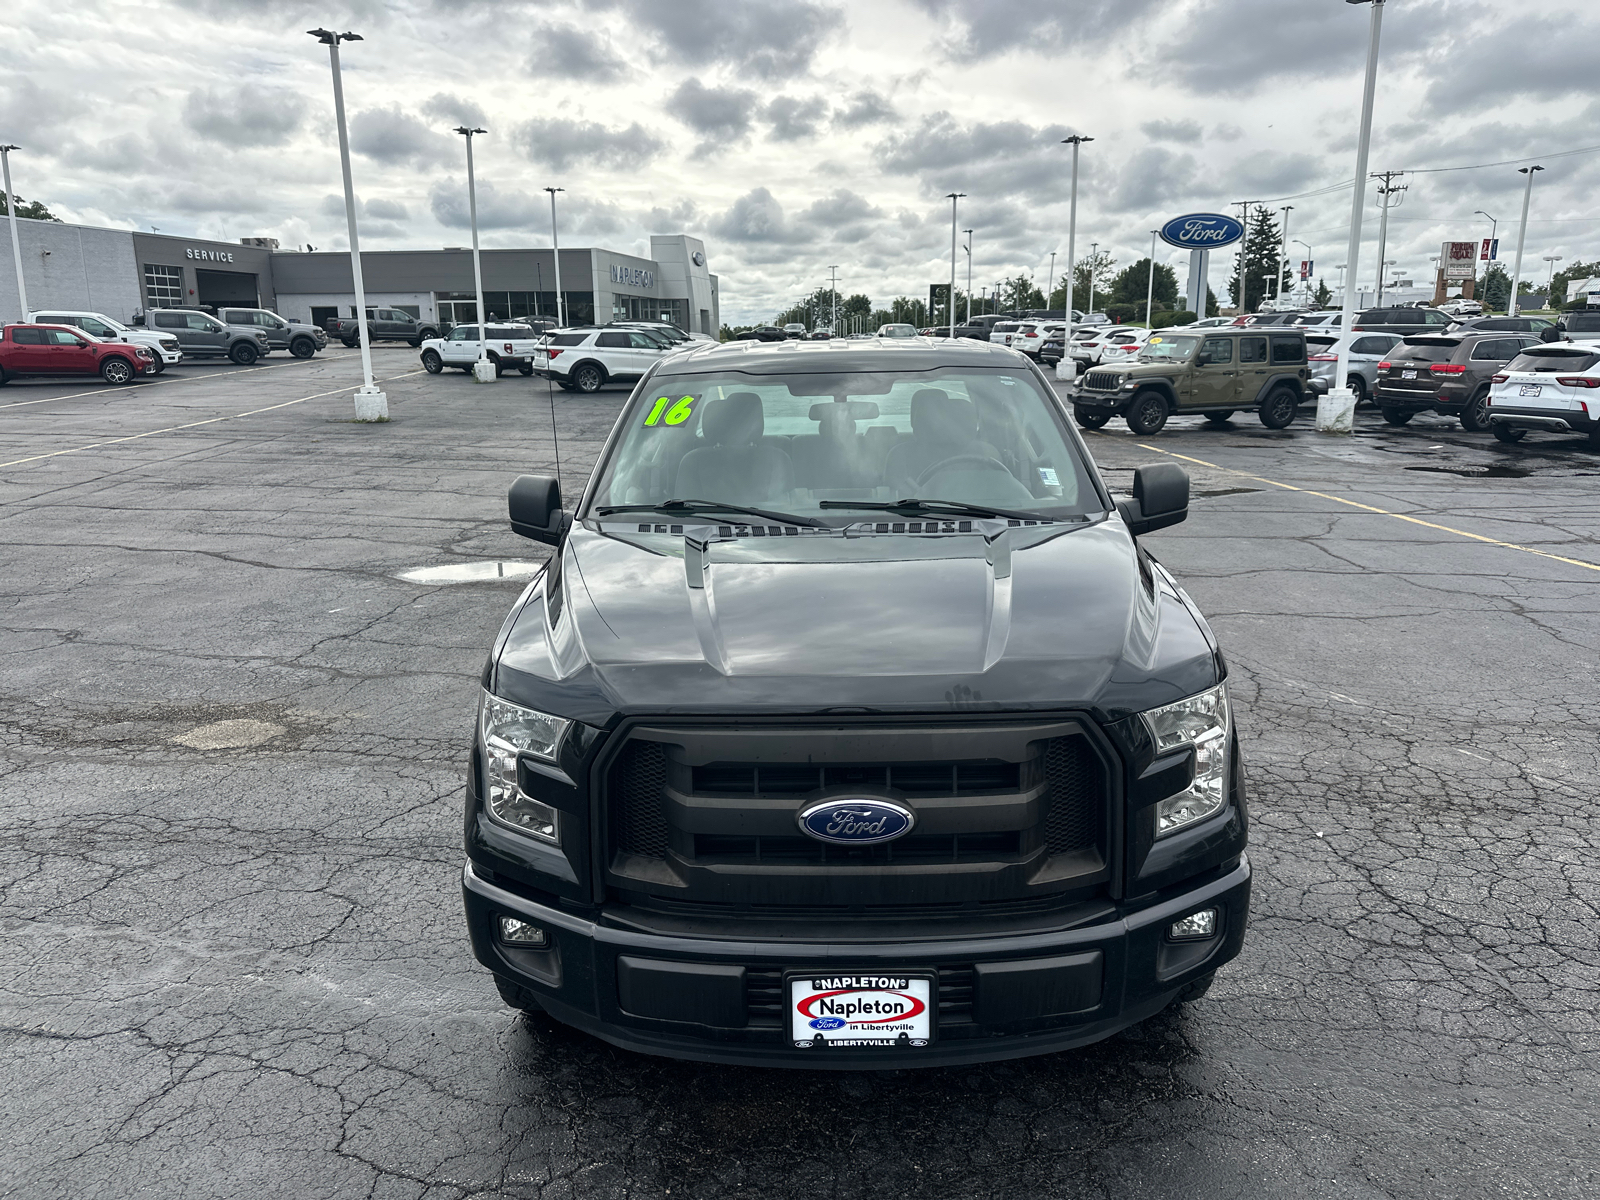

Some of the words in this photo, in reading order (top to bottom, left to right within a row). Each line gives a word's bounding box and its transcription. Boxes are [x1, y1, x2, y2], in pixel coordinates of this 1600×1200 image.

[1179, 219, 1229, 241] Ford
[186, 248, 234, 263] SERVICE
[611, 264, 654, 288] NAPLETON
[644, 395, 695, 426] 16
[826, 809, 887, 835] Ford
[820, 977, 900, 989] NAPLETON
[819, 997, 904, 1018] Napleton
[816, 1018, 839, 1029] Ford
[850, 1023, 859, 1031] in
[861, 1023, 915, 1032] Libertyville
[828, 1039, 896, 1047] LIBERTYVILLE
